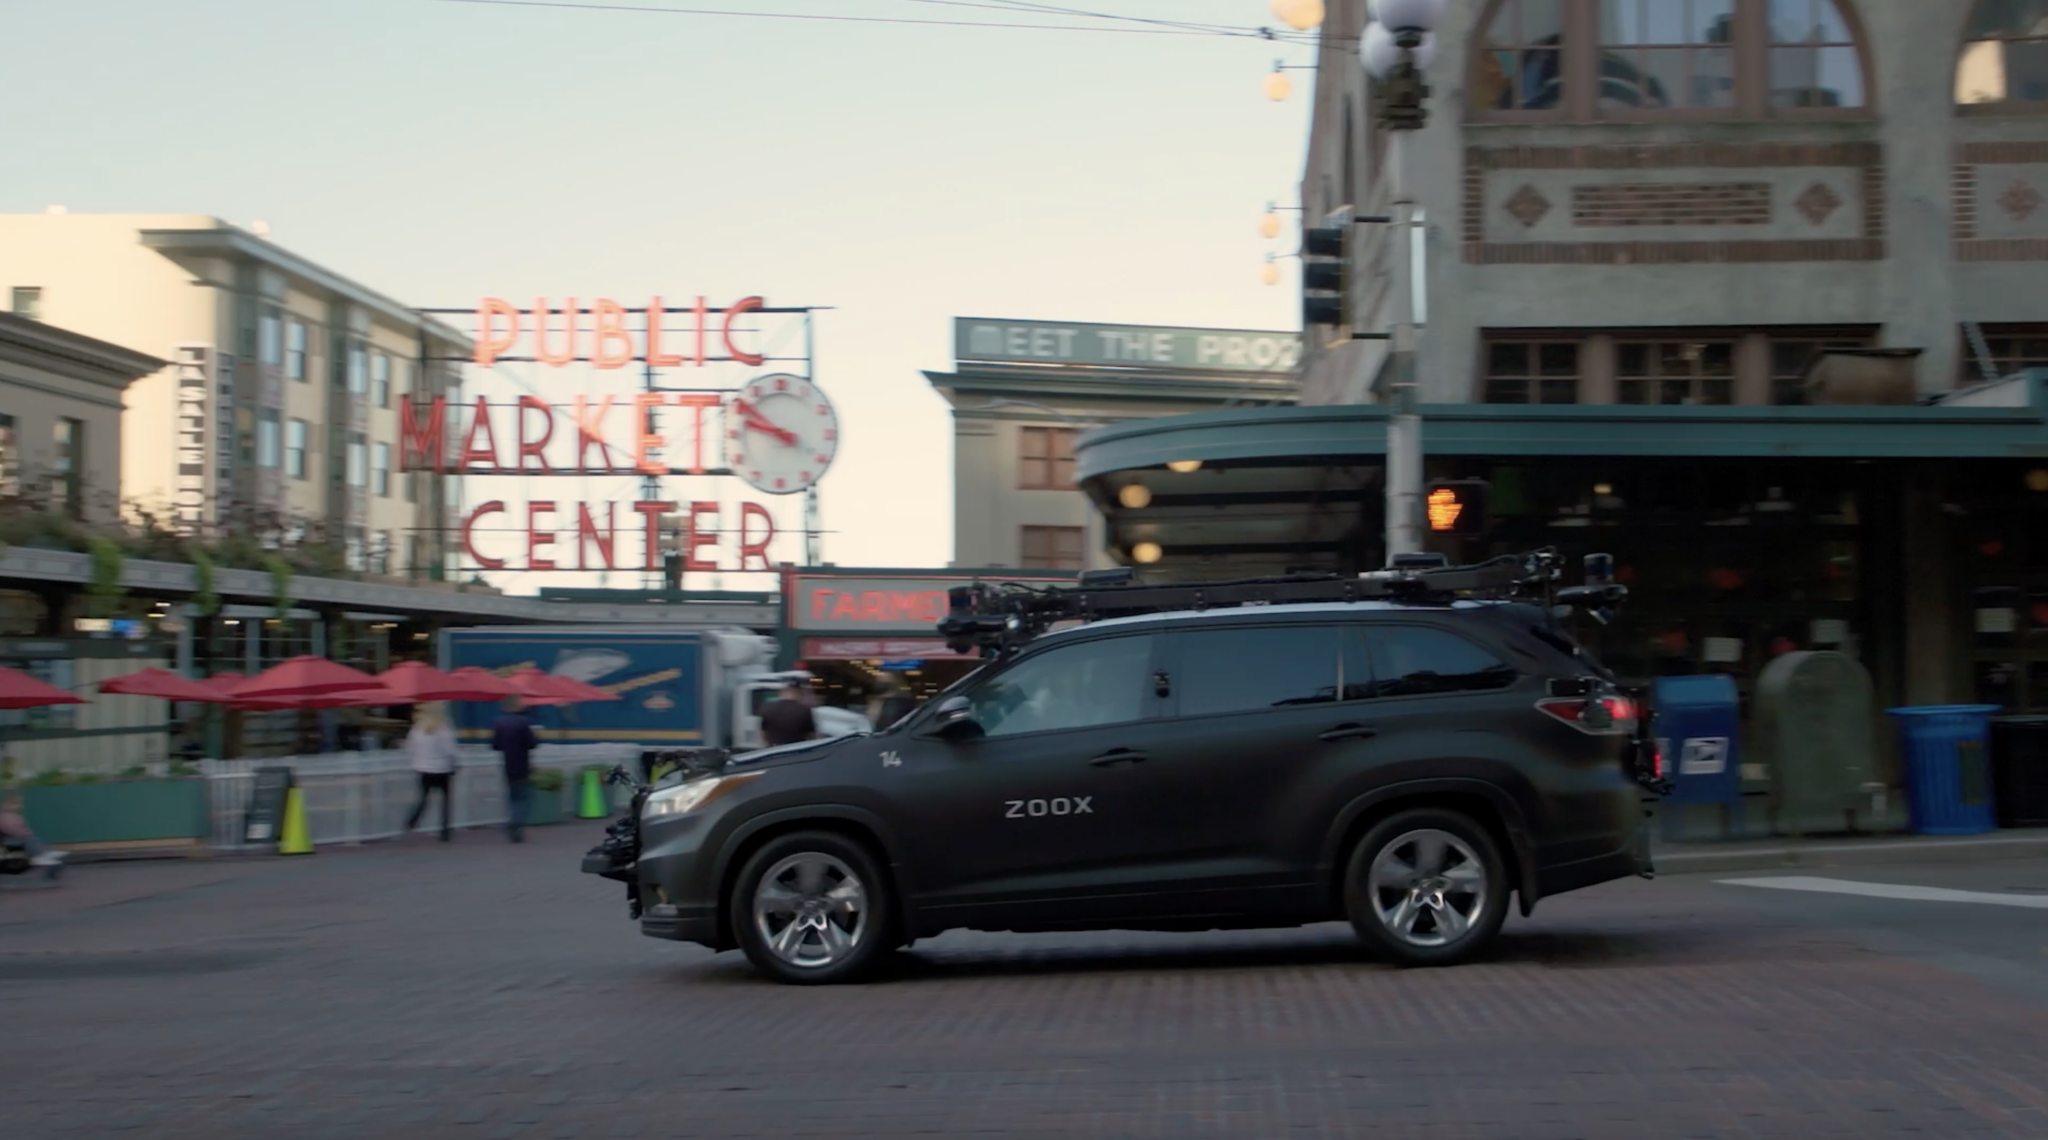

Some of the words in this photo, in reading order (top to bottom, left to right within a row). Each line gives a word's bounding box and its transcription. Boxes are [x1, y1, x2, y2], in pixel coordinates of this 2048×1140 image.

[474, 296, 763, 369] PUBLIC
[1095, 330, 1175, 362] THE
[399, 394, 721, 475] MARKET
[462, 501, 775, 571] CENTER
[811, 588, 949, 622] FARME
[879, 751, 903, 767] 14
[1004, 796, 1094, 818] ZOOX
